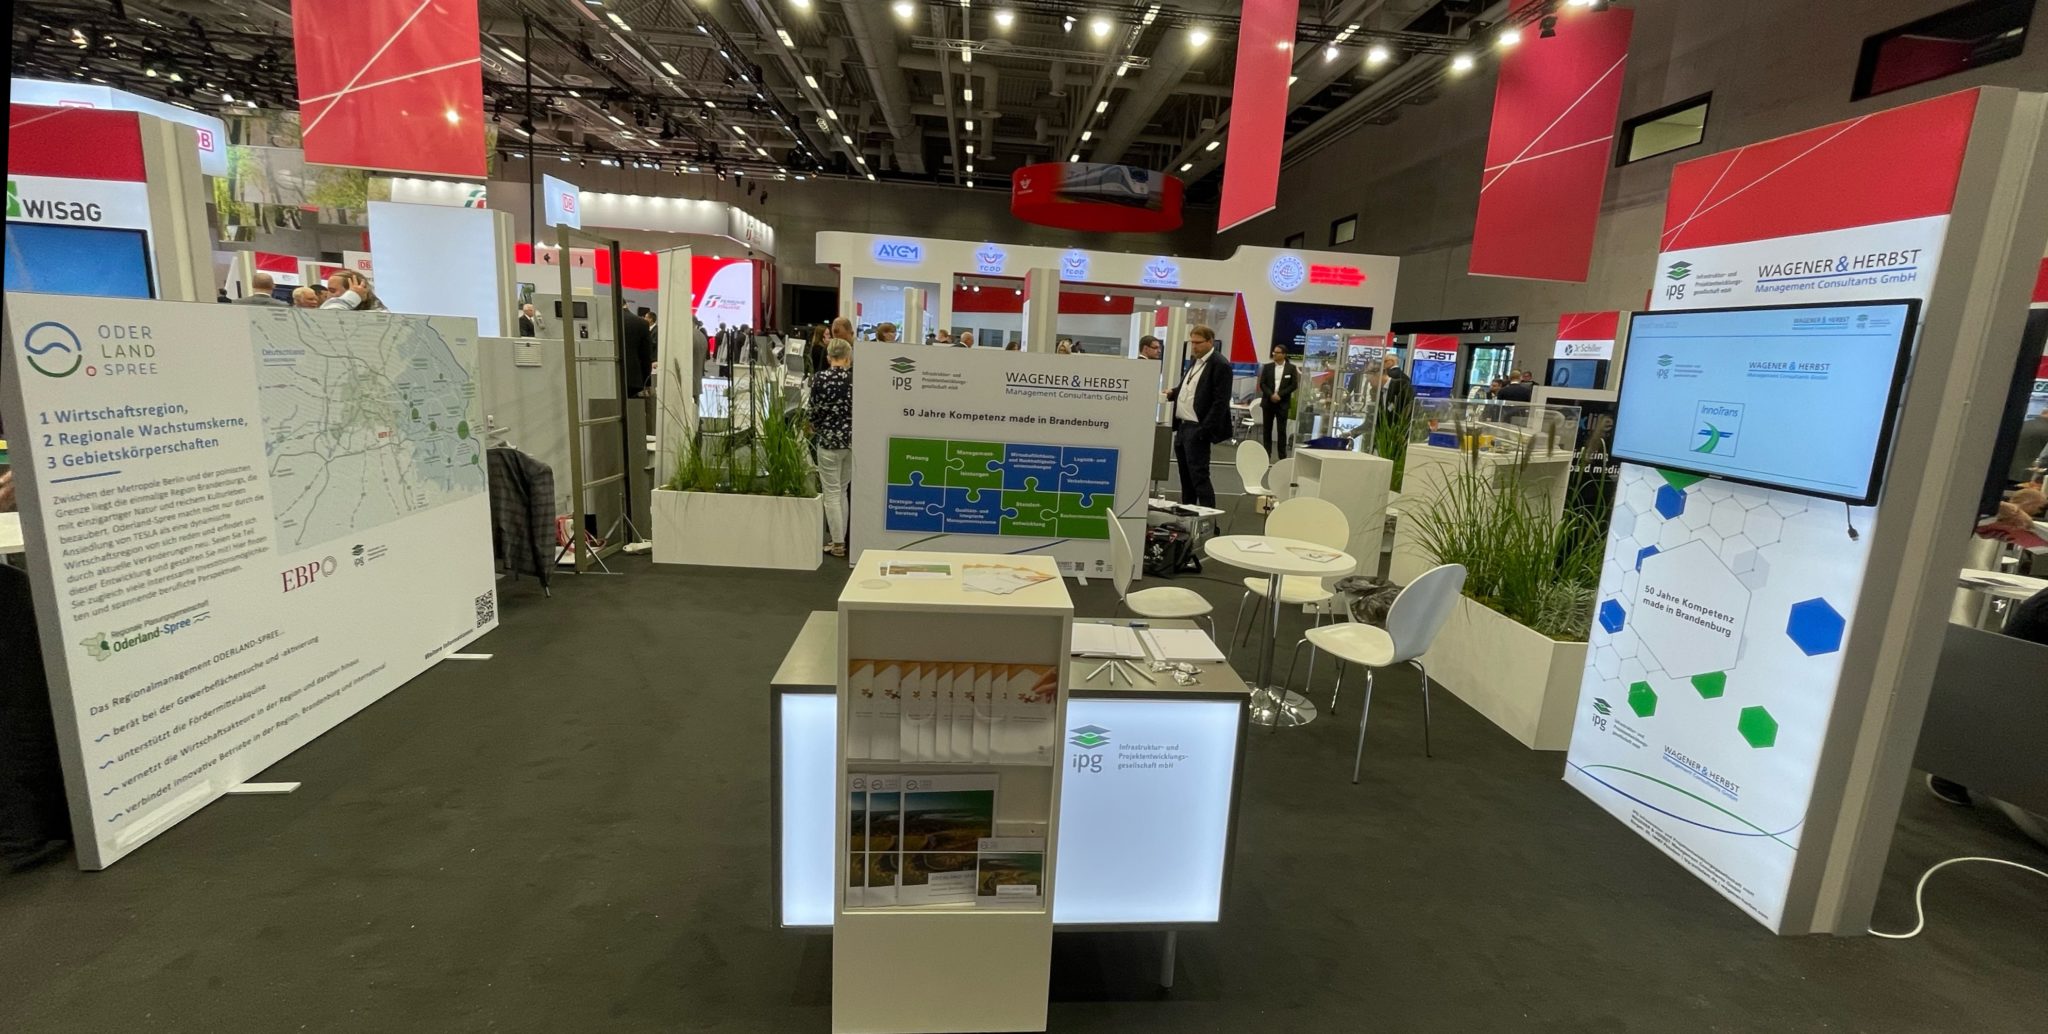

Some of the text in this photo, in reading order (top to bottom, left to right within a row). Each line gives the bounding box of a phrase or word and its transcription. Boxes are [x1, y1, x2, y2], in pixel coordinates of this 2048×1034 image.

[1757, 249, 1922, 278] WAGENER & HERBST
[1666, 284, 1685, 300] ipg
[1755, 272, 1917, 294] Management Consultants GmbH
[98, 324, 153, 339] ODER
[101, 344, 156, 359] LAND
[1428, 352, 1455, 360] RST
[104, 363, 159, 376] SPREE
[1749, 361, 1788, 370] WAGENER
[1798, 362, 1831, 371] HERBST
[892, 375, 913, 390] ipg
[1006, 371, 1130, 389] WAGENER & HERBST
[1006, 387, 1129, 402] Management Consultants GmbH
[39, 402, 189, 425] 1 Wirtschaftsregion,
[903, 408, 1110, 429] 50 Jahre Kompetenz made in Brandenburg
[1701, 404, 1739, 417] InnoTrans
[43, 415, 249, 447] 2 Regionale Wachstumskerne,
[47, 437, 219, 469] 3 Gebietskörperschaften
[100, 487, 115, 497] der
[134, 505, 158, 515] Natur
[133, 528, 159, 540] TESLA
[64, 545, 144, 570] Wirtschaftsregion
[92, 604, 110, 616] und
[1644, 585, 1735, 624] 50 Jahre Kompetenz
[1643, 597, 1732, 638] made in Brandenburg
[113, 618, 191, 652] Oderland-Spree
[89, 703, 110, 716] Das
[112, 659, 212, 707] Regionalmanagement
[113, 718, 141, 735] berät
[142, 709, 158, 722] bei
[159, 703, 175, 714] der
[177, 661, 265, 705] Gewerbeflächensuche
[265, 653, 280, 665] und
[117, 684, 267, 762] unterstützt die Fördermittelakquise
[1592, 713, 1608, 731] ipg
[121, 762, 164, 788] vernetzt
[164, 753, 178, 766] die
[180, 711, 256, 757] Wirtschaftsakteure
[266, 701, 279, 712] der
[1119, 743, 1180, 751] Infrastruktur- und
[125, 783, 171, 814] verbindet
[173, 757, 217, 787] innovative
[219, 739, 252, 761] Betriebe
[262, 726, 275, 737] der
[1072, 753, 1104, 773] ipg
[1664, 744, 1701, 771] WAGENER
[1709, 771, 1740, 792] HERBST
